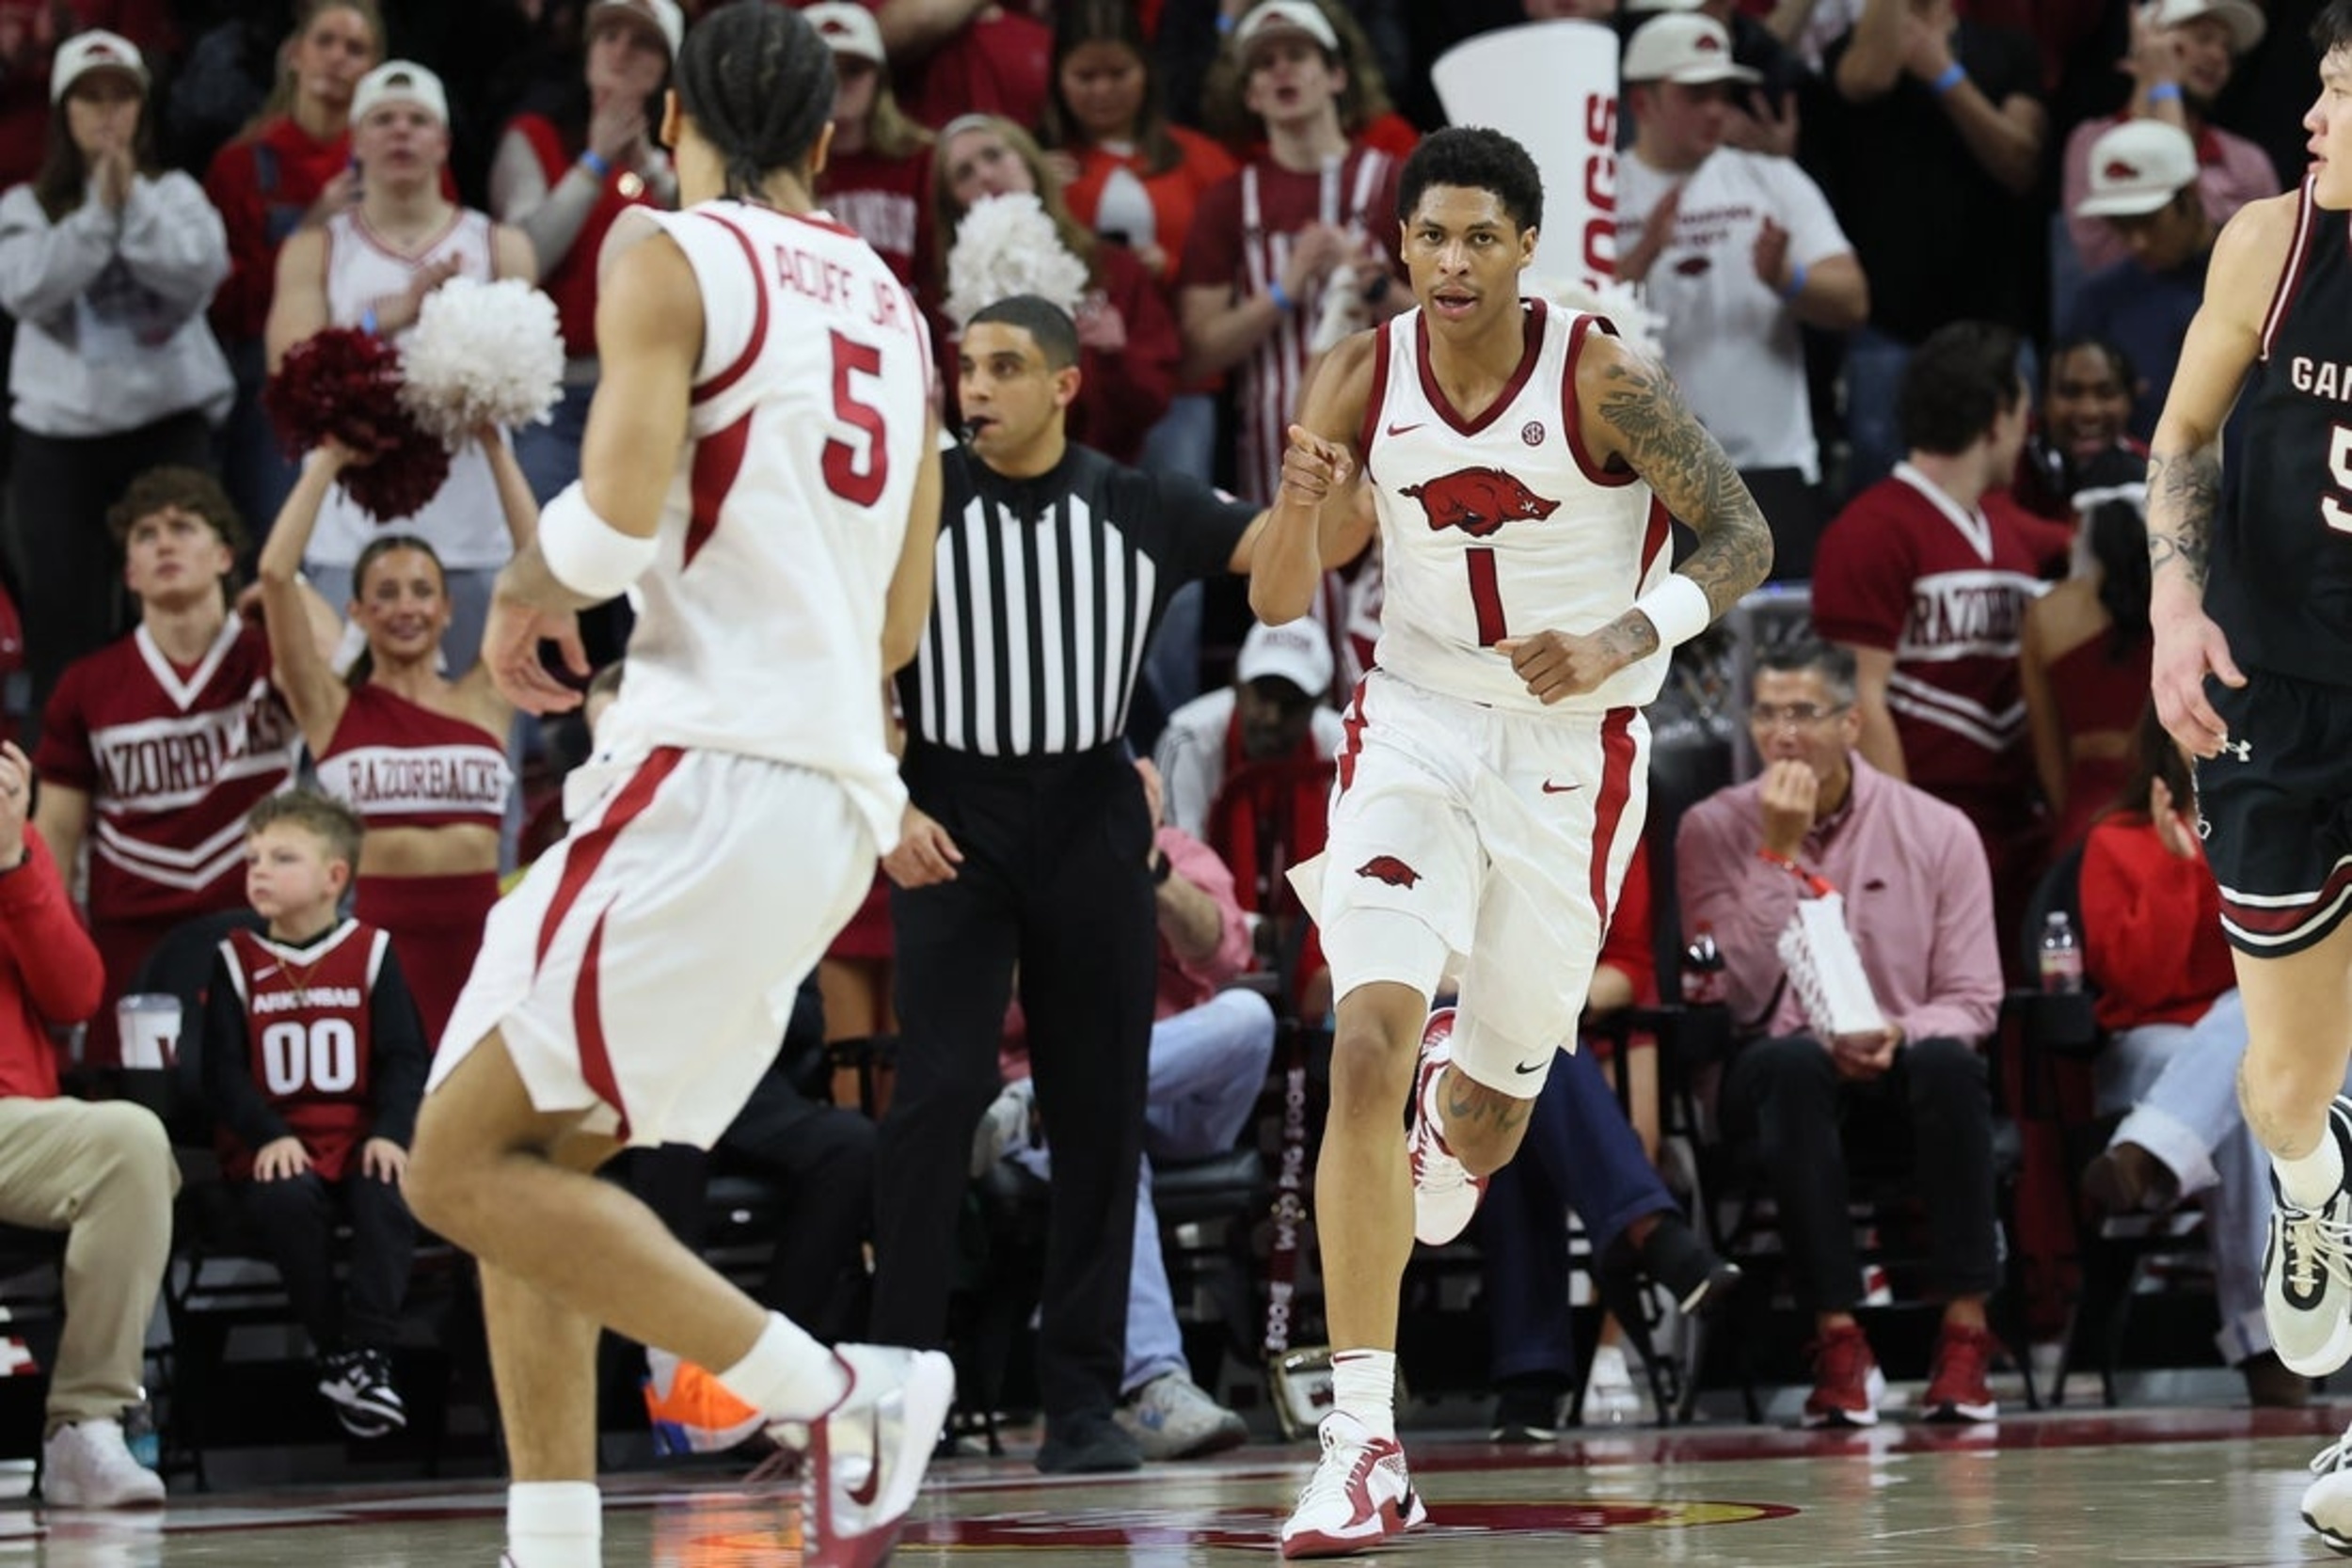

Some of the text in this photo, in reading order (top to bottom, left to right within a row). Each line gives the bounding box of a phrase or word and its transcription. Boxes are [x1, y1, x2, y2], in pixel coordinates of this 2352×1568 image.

[1584, 93, 1617, 290] OGS
[774, 245, 852, 311] ACUFF
[821, 326, 888, 508] 5
[1465, 547, 1507, 648] 1
[252, 987, 361, 1014] ARKANSAS
[262, 1018, 358, 1096] 00
